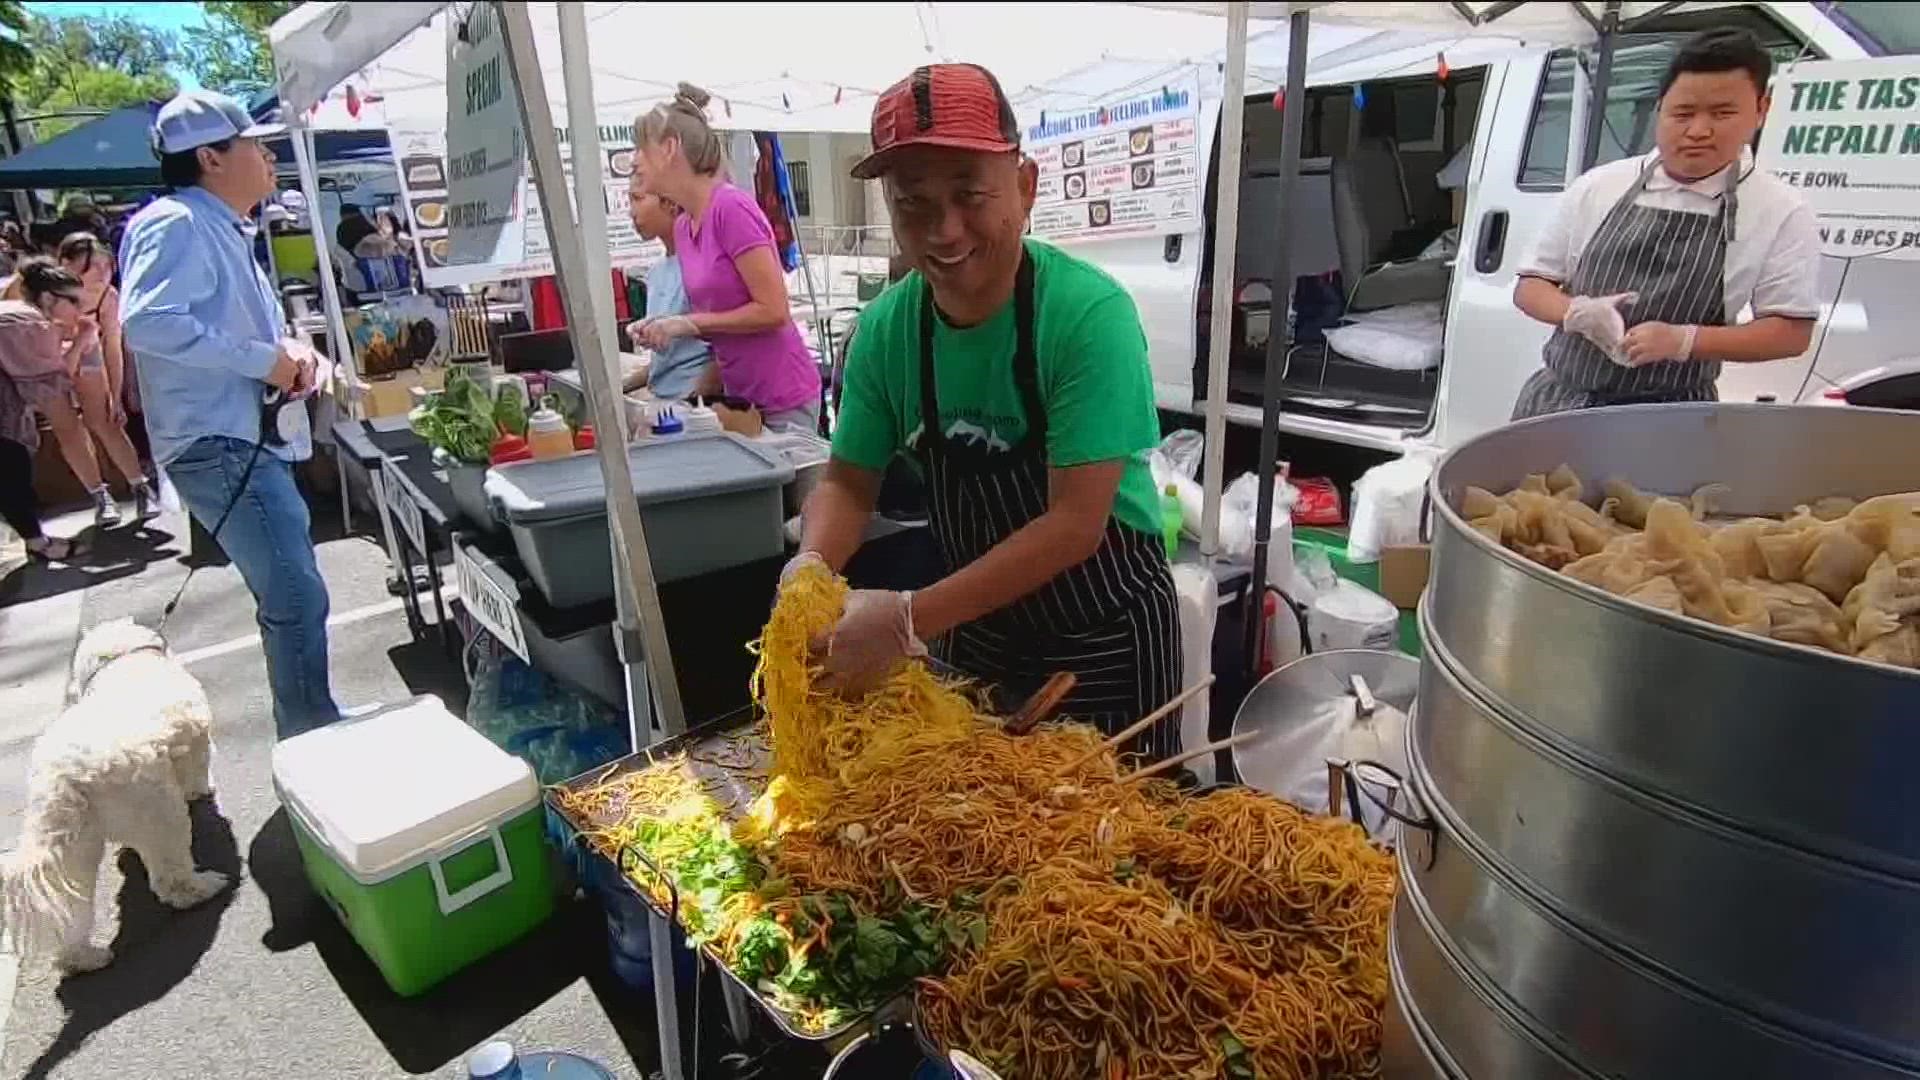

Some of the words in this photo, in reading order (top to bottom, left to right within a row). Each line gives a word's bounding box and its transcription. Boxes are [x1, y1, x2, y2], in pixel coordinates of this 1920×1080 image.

[466, 52, 501, 116] SPECIAL
[1790, 81, 1849, 111] THE
[1857, 78, 1920, 110] TAS
[1030, 117, 1072, 140] WELCOME
[1075, 115, 1087, 130] TO
[1152, 92, 1188, 111] MMO
[1782, 123, 1894, 155] NEPALI
[1804, 172, 1849, 188] BOWL
[1833, 229, 1846, 245] &
